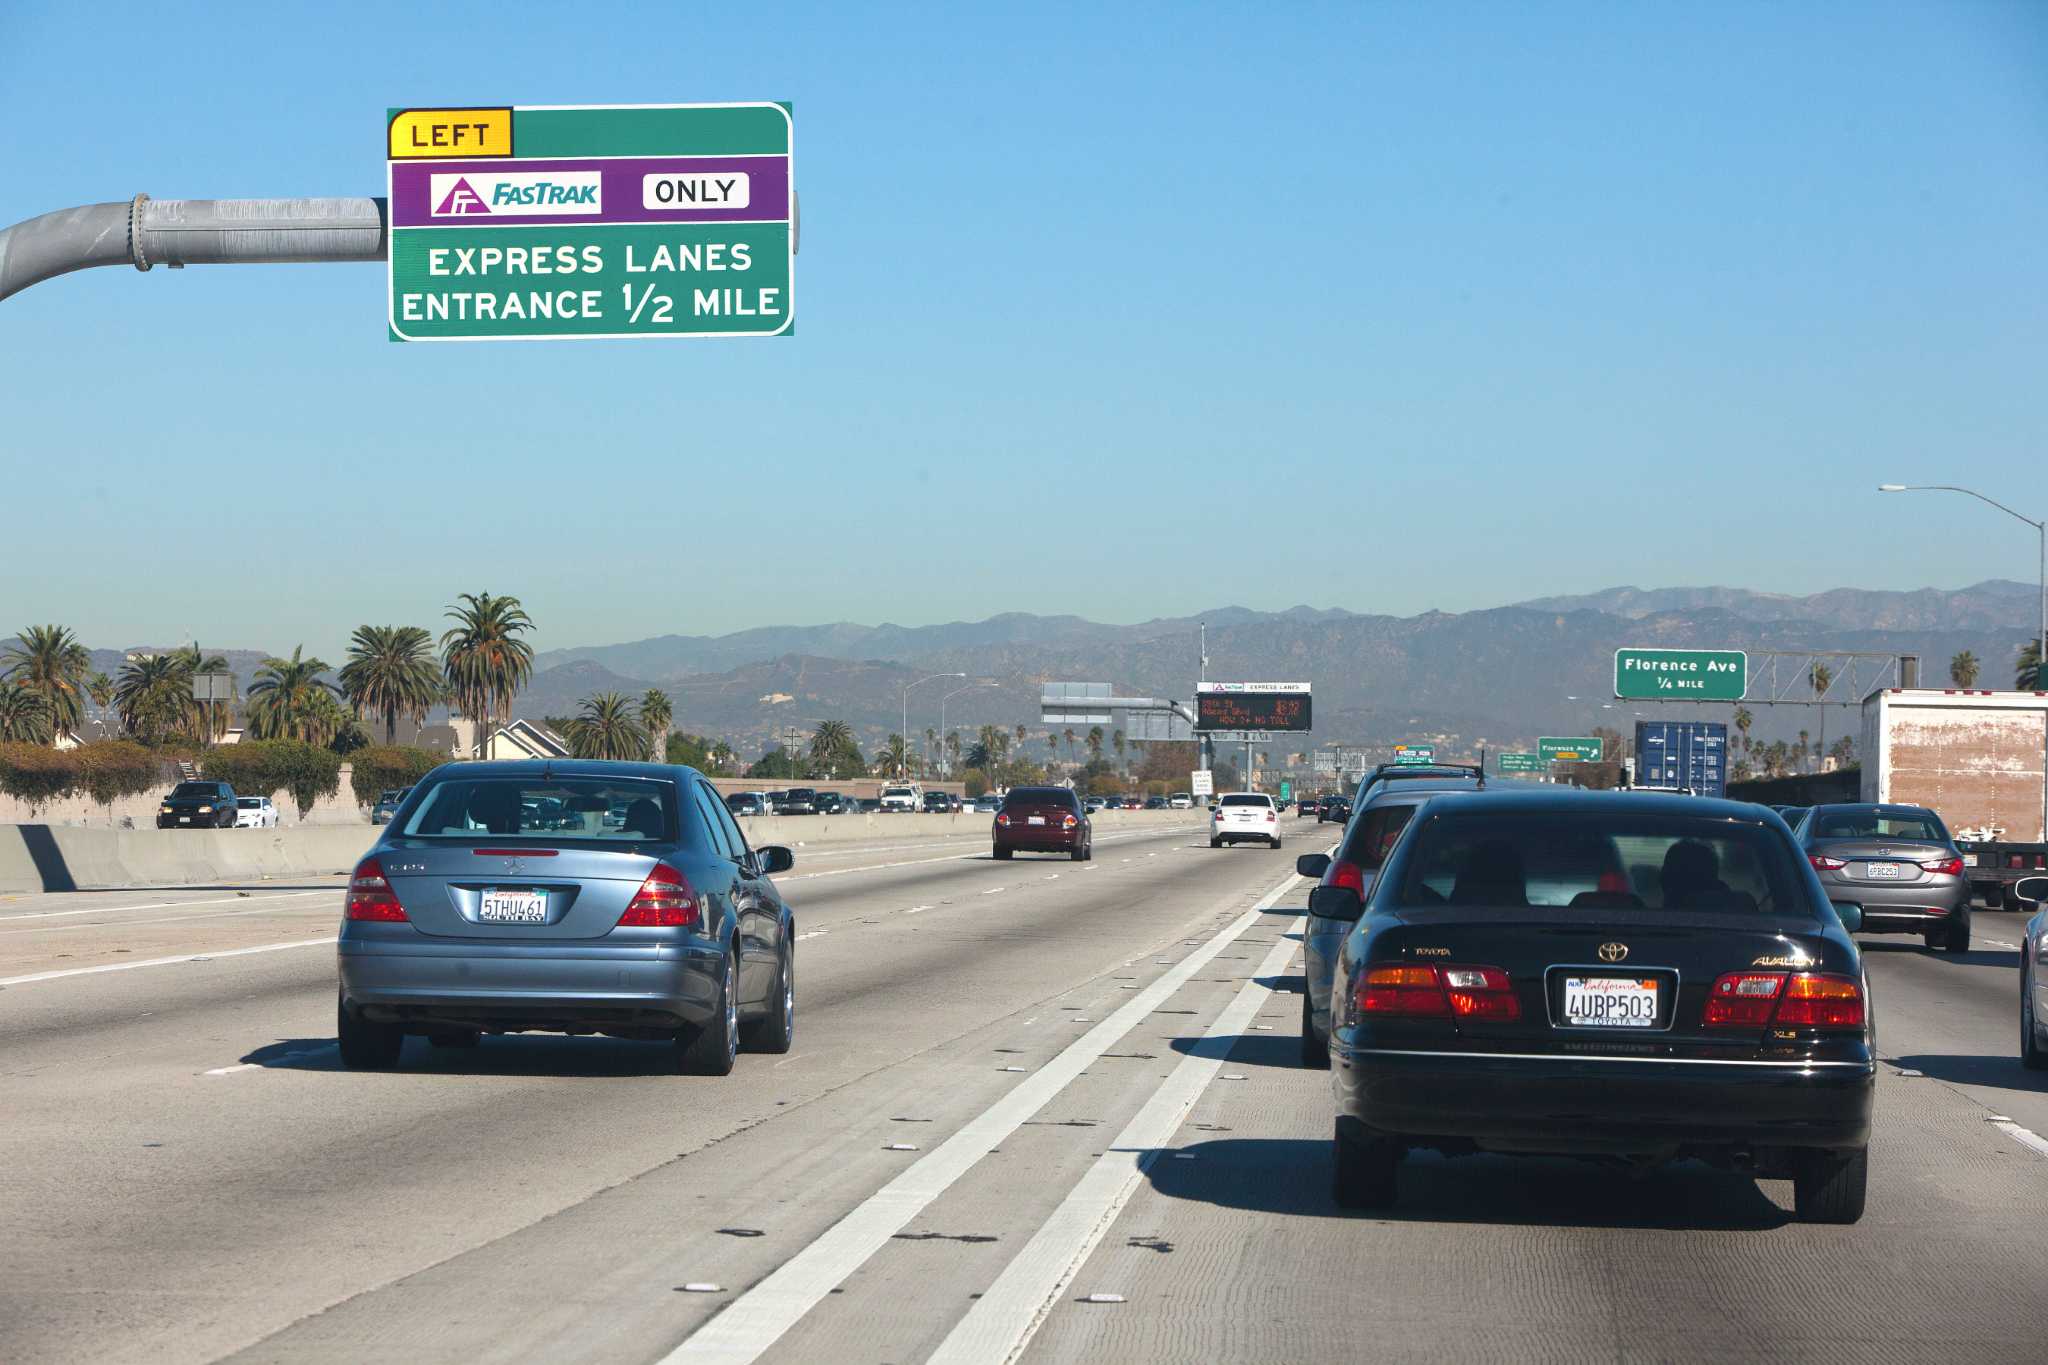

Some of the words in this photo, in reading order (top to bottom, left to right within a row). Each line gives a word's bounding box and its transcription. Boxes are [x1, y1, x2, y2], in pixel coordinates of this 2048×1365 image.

[412, 123, 490, 147] LEFT
[655, 179, 736, 203] ONLY
[429, 246, 604, 276] EXPRESS
[626, 243, 752, 273] LANES
[403, 290, 602, 321] ENTRANCE
[693, 288, 780, 316] MILE
[1625, 658, 1698, 672] Florence
[1707, 660, 1737, 672] Ave
[1677, 680, 1704, 688] MILE
[484, 900, 543, 916] 5THU461
[1415, 948, 1451, 956] TOYOTA
[1752, 956, 1815, 966] AVALON
[1584, 980, 1634, 993] California
[1569, 994, 1654, 1018] 4UBP503
[1774, 1030, 1796, 1039] XLS
